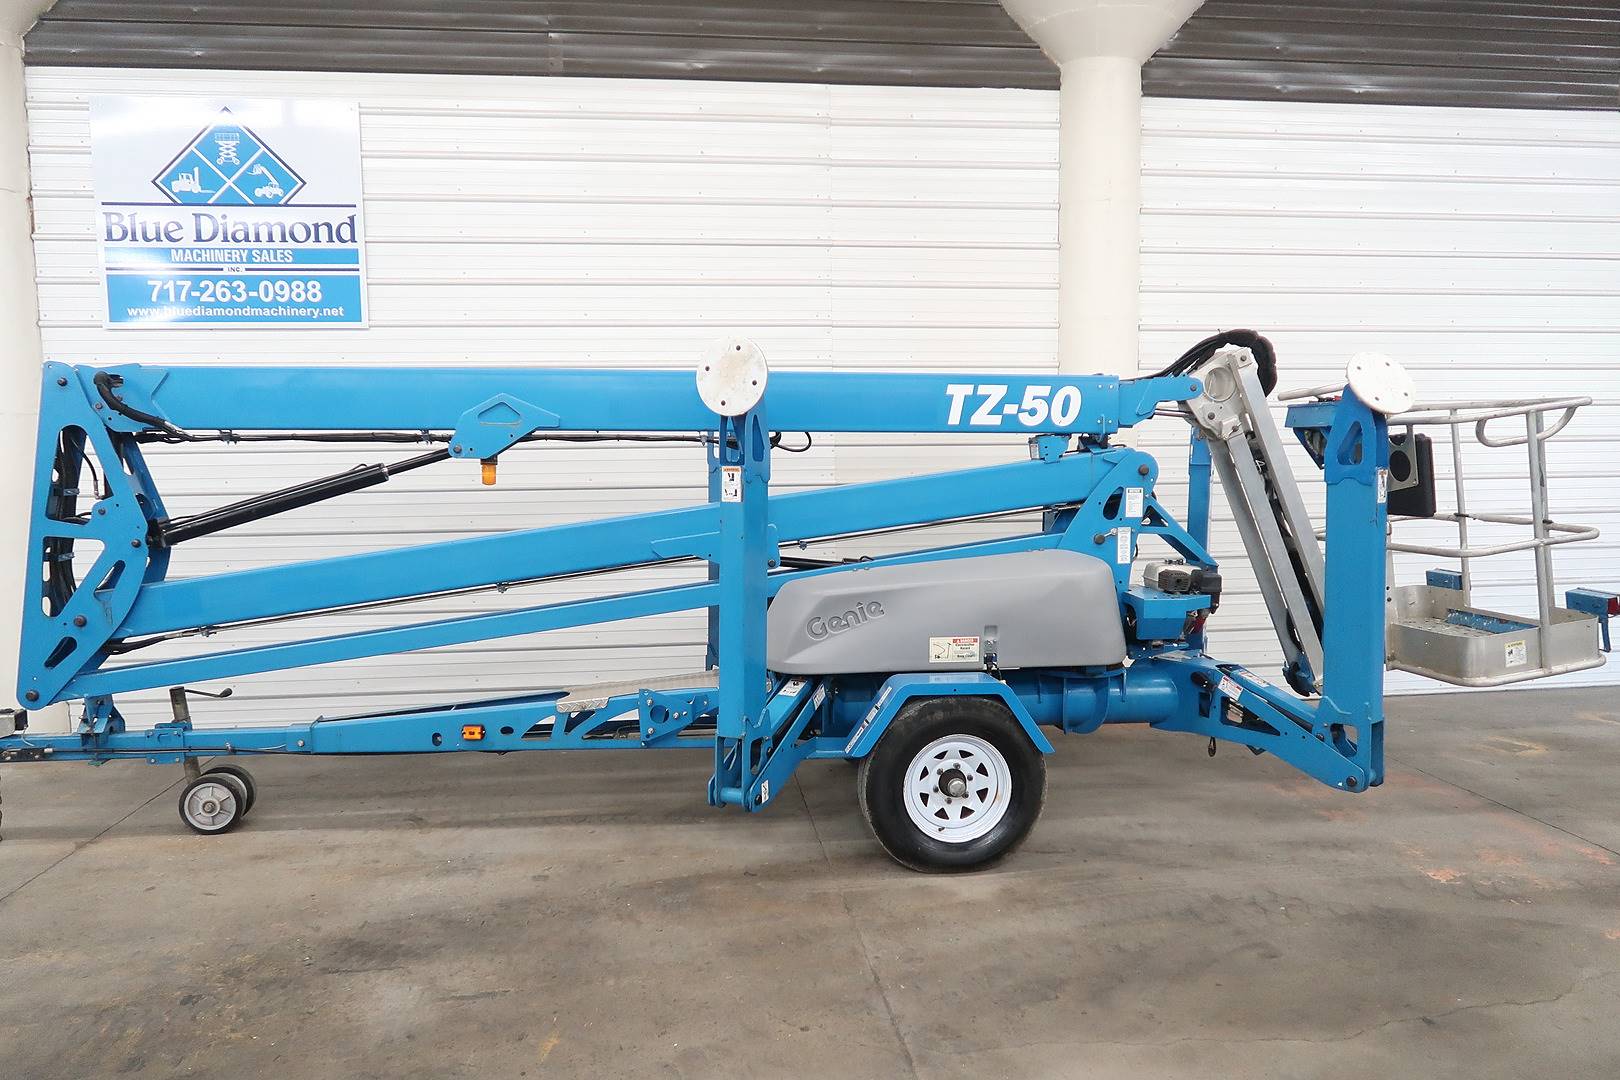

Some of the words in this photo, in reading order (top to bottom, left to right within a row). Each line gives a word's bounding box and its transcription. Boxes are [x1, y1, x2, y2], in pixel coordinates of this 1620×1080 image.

[103, 211, 183, 242] Blue
[191, 212, 357, 244] Diamond
[170, 248, 248, 262] MACHINERY
[252, 249, 293, 263] SALES
[147, 280, 322, 303] 717-263-0988
[946, 384, 1082, 427] TZ-50
[806, 601, 885, 641] Genie
